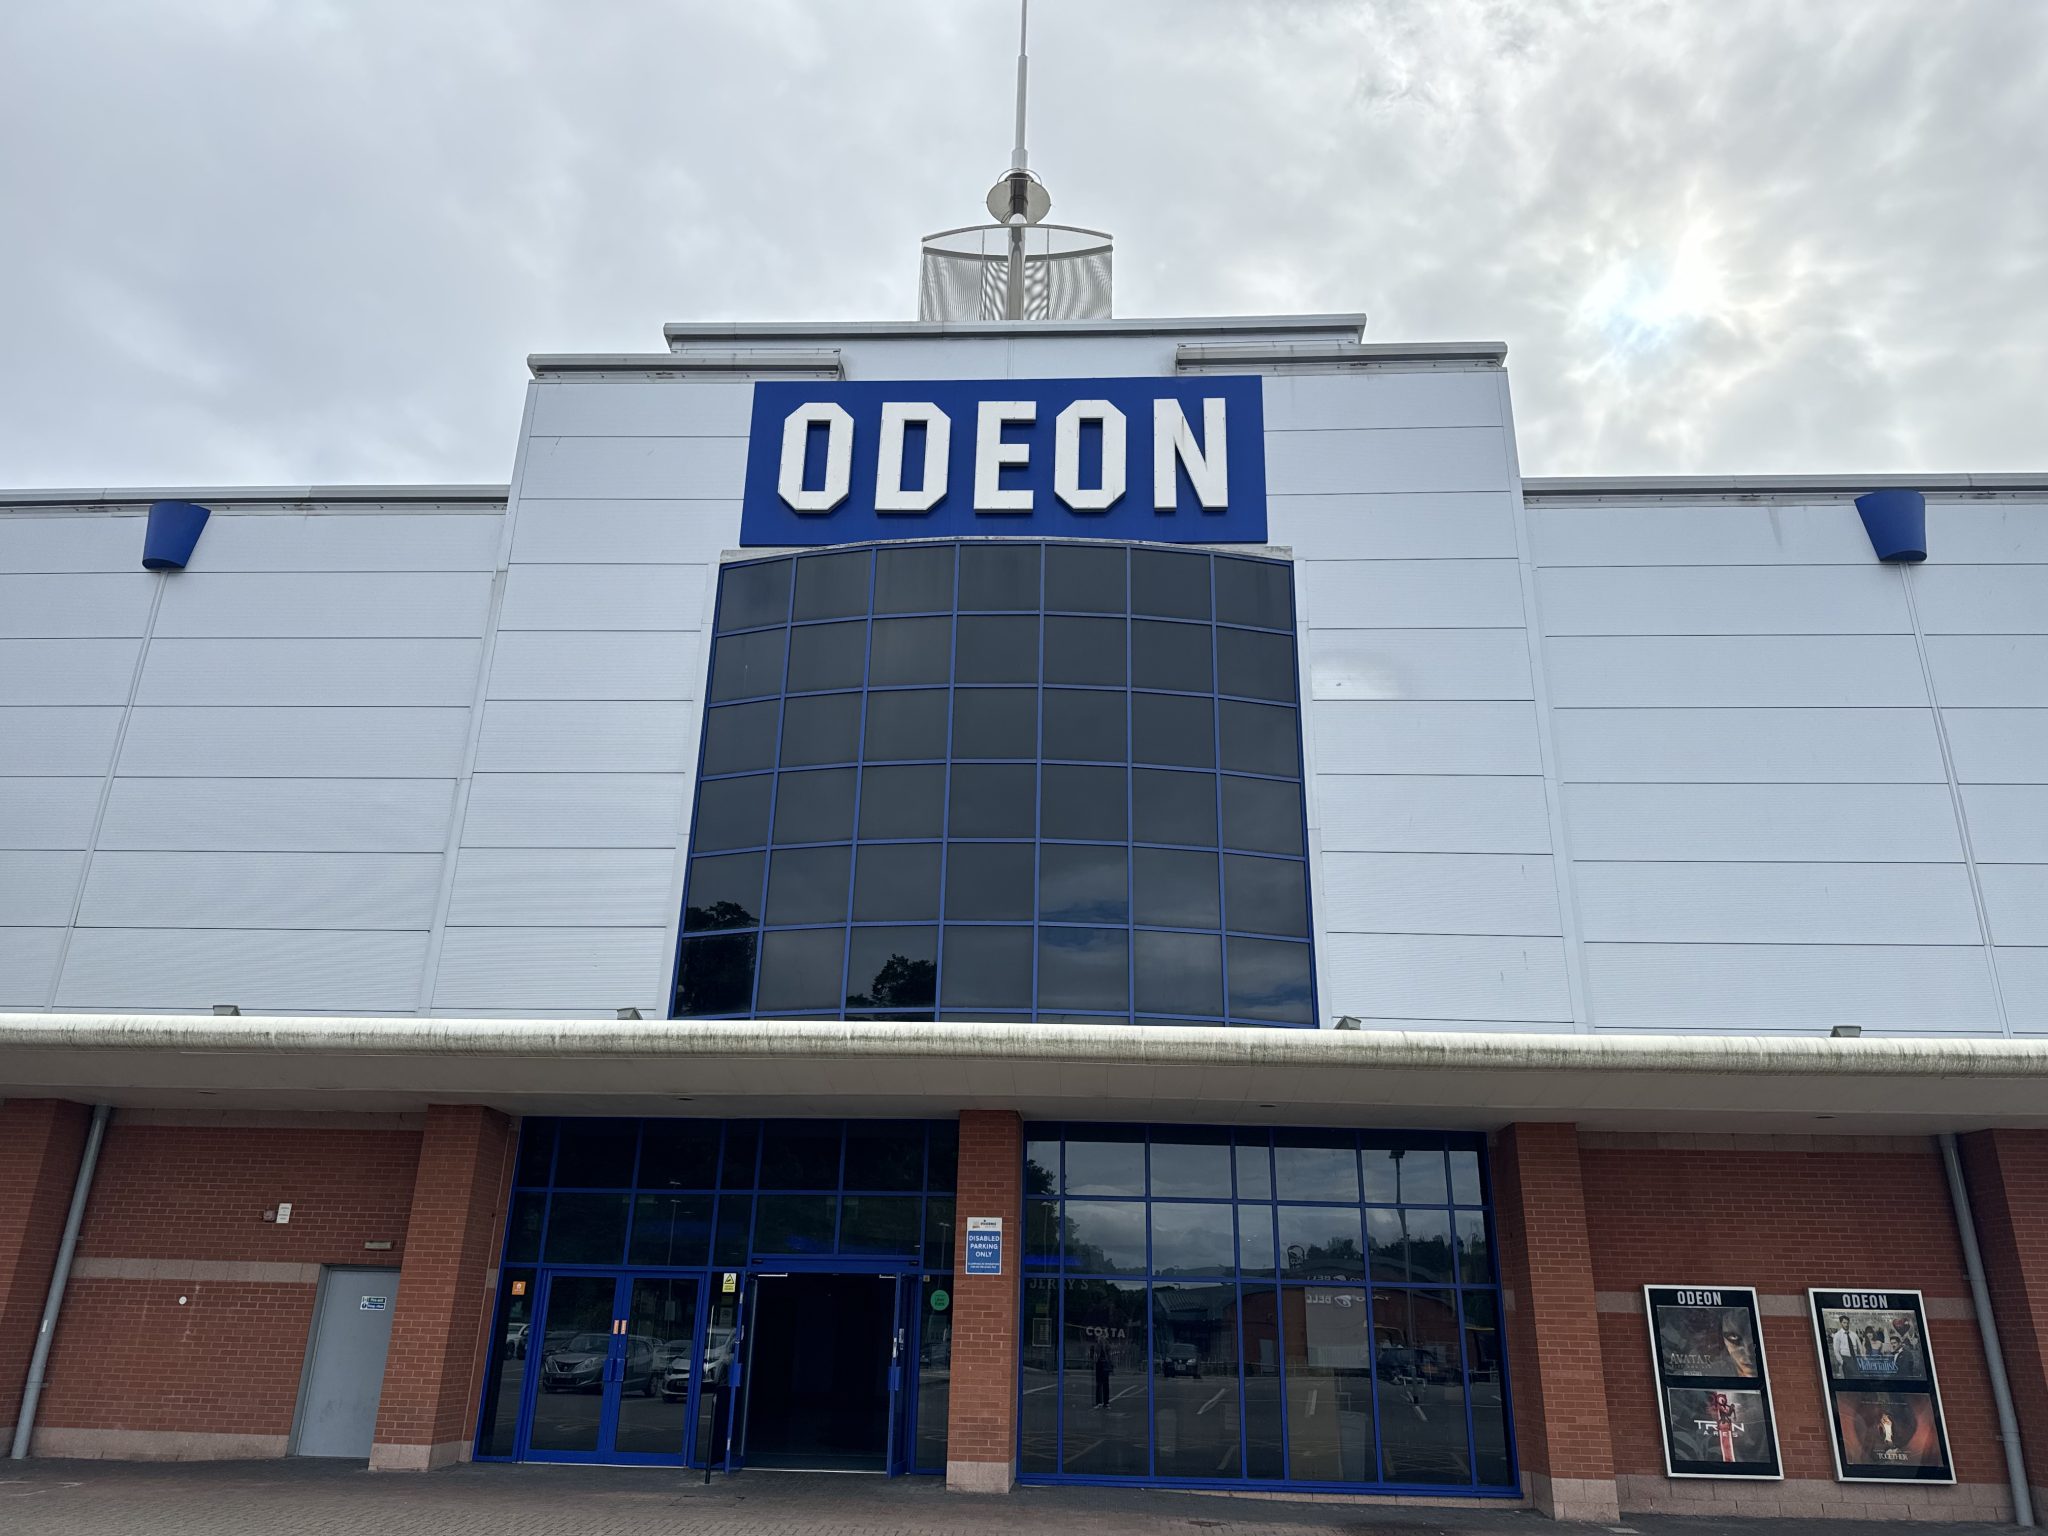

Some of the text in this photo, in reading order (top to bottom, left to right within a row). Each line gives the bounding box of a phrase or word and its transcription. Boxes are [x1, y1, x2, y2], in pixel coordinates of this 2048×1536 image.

[778, 398, 1228, 512] ODEON
[1677, 1290, 1722, 1306] ODEON
[1842, 1293, 1888, 1309] ODEON
[1085, 1325, 1126, 1338] COSTA
[1669, 1353, 1713, 1366] AVATAR
[1703, 1430, 1739, 1438] ARES
